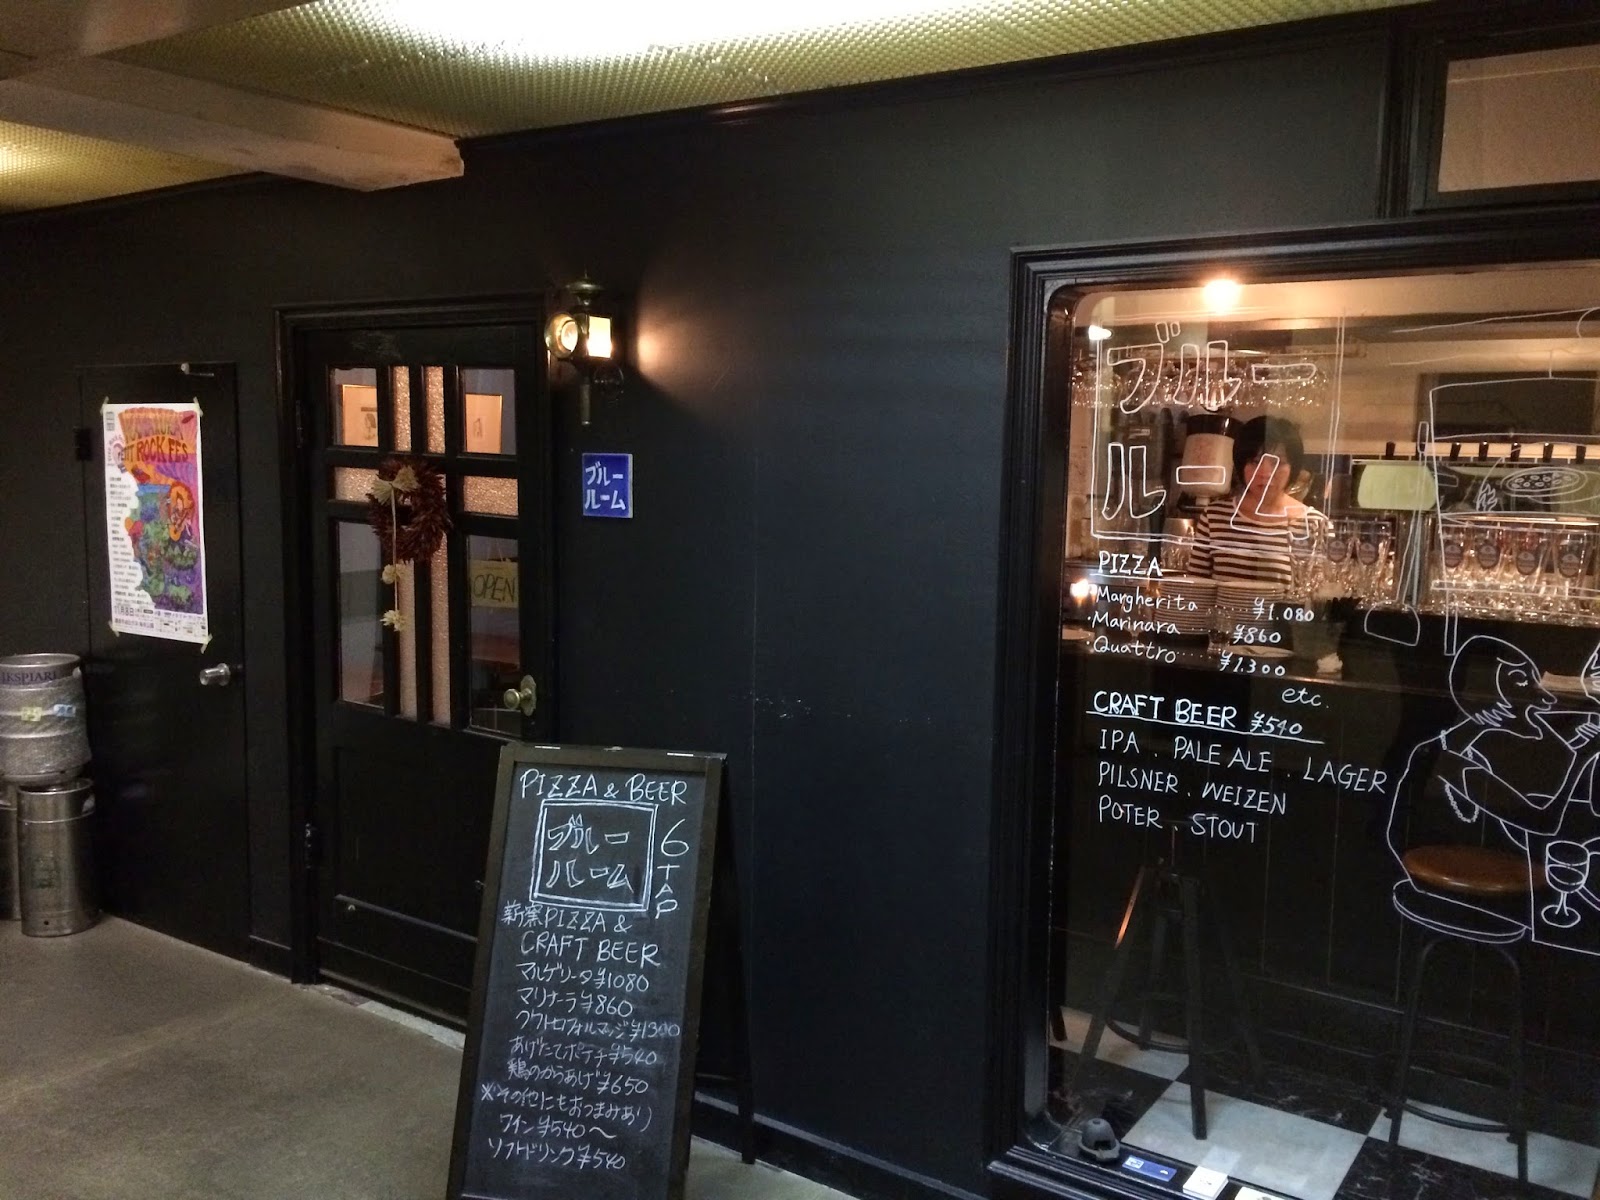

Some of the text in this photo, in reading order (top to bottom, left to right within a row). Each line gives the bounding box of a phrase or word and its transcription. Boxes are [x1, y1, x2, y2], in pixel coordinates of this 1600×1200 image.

[1107, 321, 1317, 414] ブルー
[136, 436, 167, 463] ROCK
[168, 438, 189, 463] FES
[585, 461, 624, 486] ブルー
[1101, 442, 1310, 540] ルーム
[584, 488, 626, 511] ルーム
[1098, 551, 1163, 577] PIZZA
[472, 573, 516, 603] OPEN
[1095, 585, 1198, 613] Margherita
[1233, 624, 1281, 644] ¥860
[1093, 691, 1303, 736] CRAFT BEER ¥540
[1099, 729, 1387, 794] IPA PALE ALE LAGER
[520, 768, 688, 805] PIZZA & BEER
[1098, 761, 1286, 815] PILSNER WEIZEN
[548, 814, 630, 855] ブルー
[1098, 795, 1259, 843] POTER STOUT
[546, 859, 634, 893] ルーム
[613, 914, 633, 933] &
[520, 930, 661, 969] CRAFT BEER
